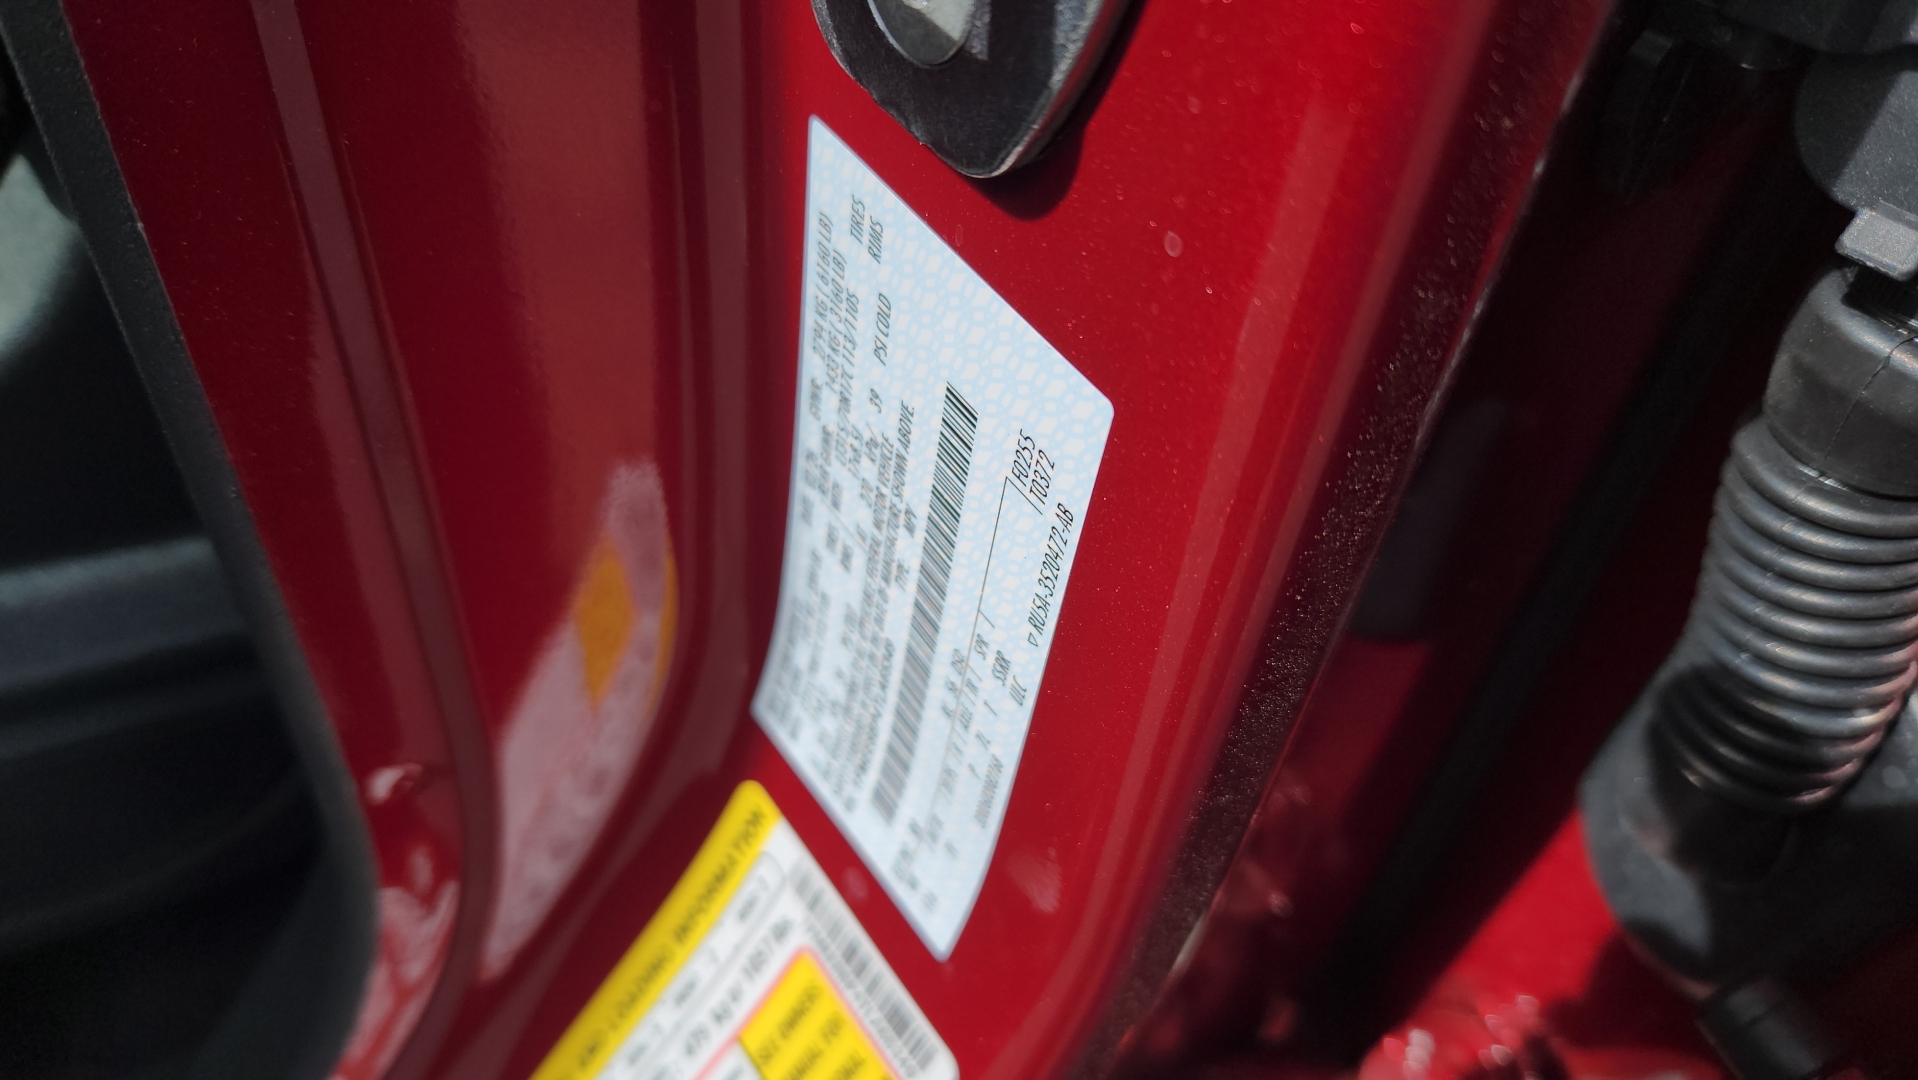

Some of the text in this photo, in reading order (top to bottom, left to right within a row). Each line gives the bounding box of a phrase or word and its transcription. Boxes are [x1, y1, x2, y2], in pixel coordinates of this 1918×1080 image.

[818, 208, 833, 246] LB)
[850, 192, 865, 246] TIRES
[867, 213, 883, 264] RIMS
[816, 239, 831, 288] 6160
[832, 245, 847, 282] LB)
[815, 293, 827, 323] KG
[829, 275, 844, 324] 3160
[876, 289, 892, 340] COLD
[812, 317, 824, 363] 2794
[828, 329, 840, 358] KG
[842, 286, 859, 368] 113/110S
[873, 333, 887, 366] PSI
[825, 352, 839, 396] 1433
[870, 386, 882, 415] 39
[897, 396, 915, 454] ABOVE.
[878, 432, 894, 490] VEHICLE
[891, 447, 908, 504] SHOWN
[1012, 427, 1035, 487] F0255
[1030, 447, 1054, 507] T0372
[860, 476, 873, 509] 270
[872, 483, 887, 535] MOTOR
[879, 497, 901, 588] MANUFACTURE
[903, 502, 917, 539] MPV
[1028, 500, 1074, 636] RU5A-3520472-AB
[957, 700, 972, 733] AXLE
[974, 631, 989, 662] SPR
[991, 647, 1010, 687] SSRR
[1009, 673, 1027, 707] ULC
[603, 938, 673, 1035] LOADING
[669, 802, 767, 947] INFORMATION
